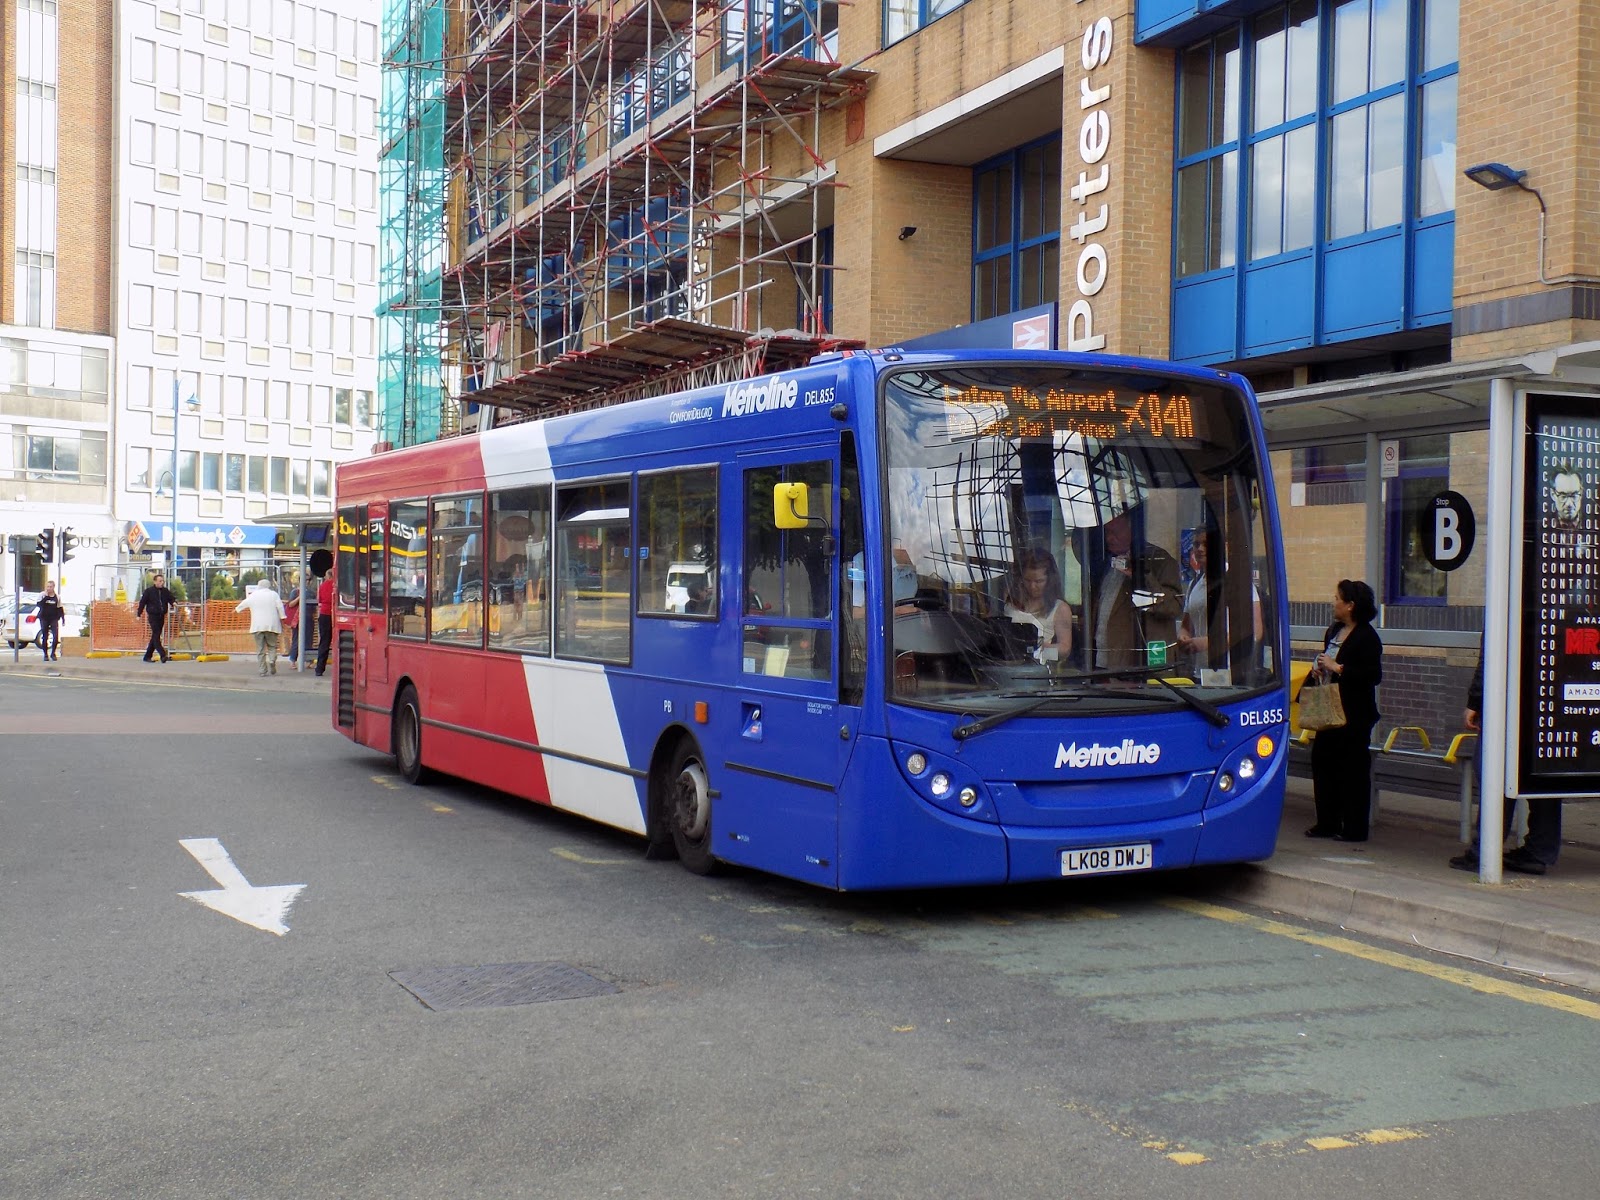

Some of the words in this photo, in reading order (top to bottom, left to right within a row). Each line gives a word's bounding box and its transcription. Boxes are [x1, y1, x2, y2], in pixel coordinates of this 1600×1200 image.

[1068, 16, 1113, 352] Potters
[721, 375, 799, 418] Metroline
[804, 387, 835, 406] DEL855
[1046, 388, 1117, 412] Airport
[1018, 416, 1045, 436] Bar
[1543, 425, 1599, 438] CONTROL
[1543, 441, 1599, 453] CONTROL
[1543, 456, 1599, 468] CONTROL
[1436, 498, 1449, 506] Stop
[1435, 508, 1462, 560] B
[1542, 533, 1599, 545] CONTROL
[1542, 548, 1599, 559] CONTROL
[1542, 563, 1598, 574] CONTROL
[1541, 578, 1598, 590] CONTROL
[1541, 593, 1598, 605] CONTROL
[1541, 609, 1565, 620] CON
[1541, 624, 1556, 635] CO
[1540, 639, 1555, 651] CO
[1540, 655, 1555, 666] CO
[1540, 670, 1555, 681] CO
[1540, 685, 1554, 696] CO
[663, 699, 673, 713] PB
[1539, 701, 1554, 712] CO
[1563, 706, 1586, 715] Start
[1240, 708, 1283, 727] DEL855
[1539, 716, 1554, 727] CO
[1538, 731, 1578, 743] CONTR
[1054, 739, 1161, 769] Metroline
[1538, 746, 1577, 758] CONTR
[1068, 850, 1110, 871] LK08
[1115, 847, 1146, 867] DWJ
